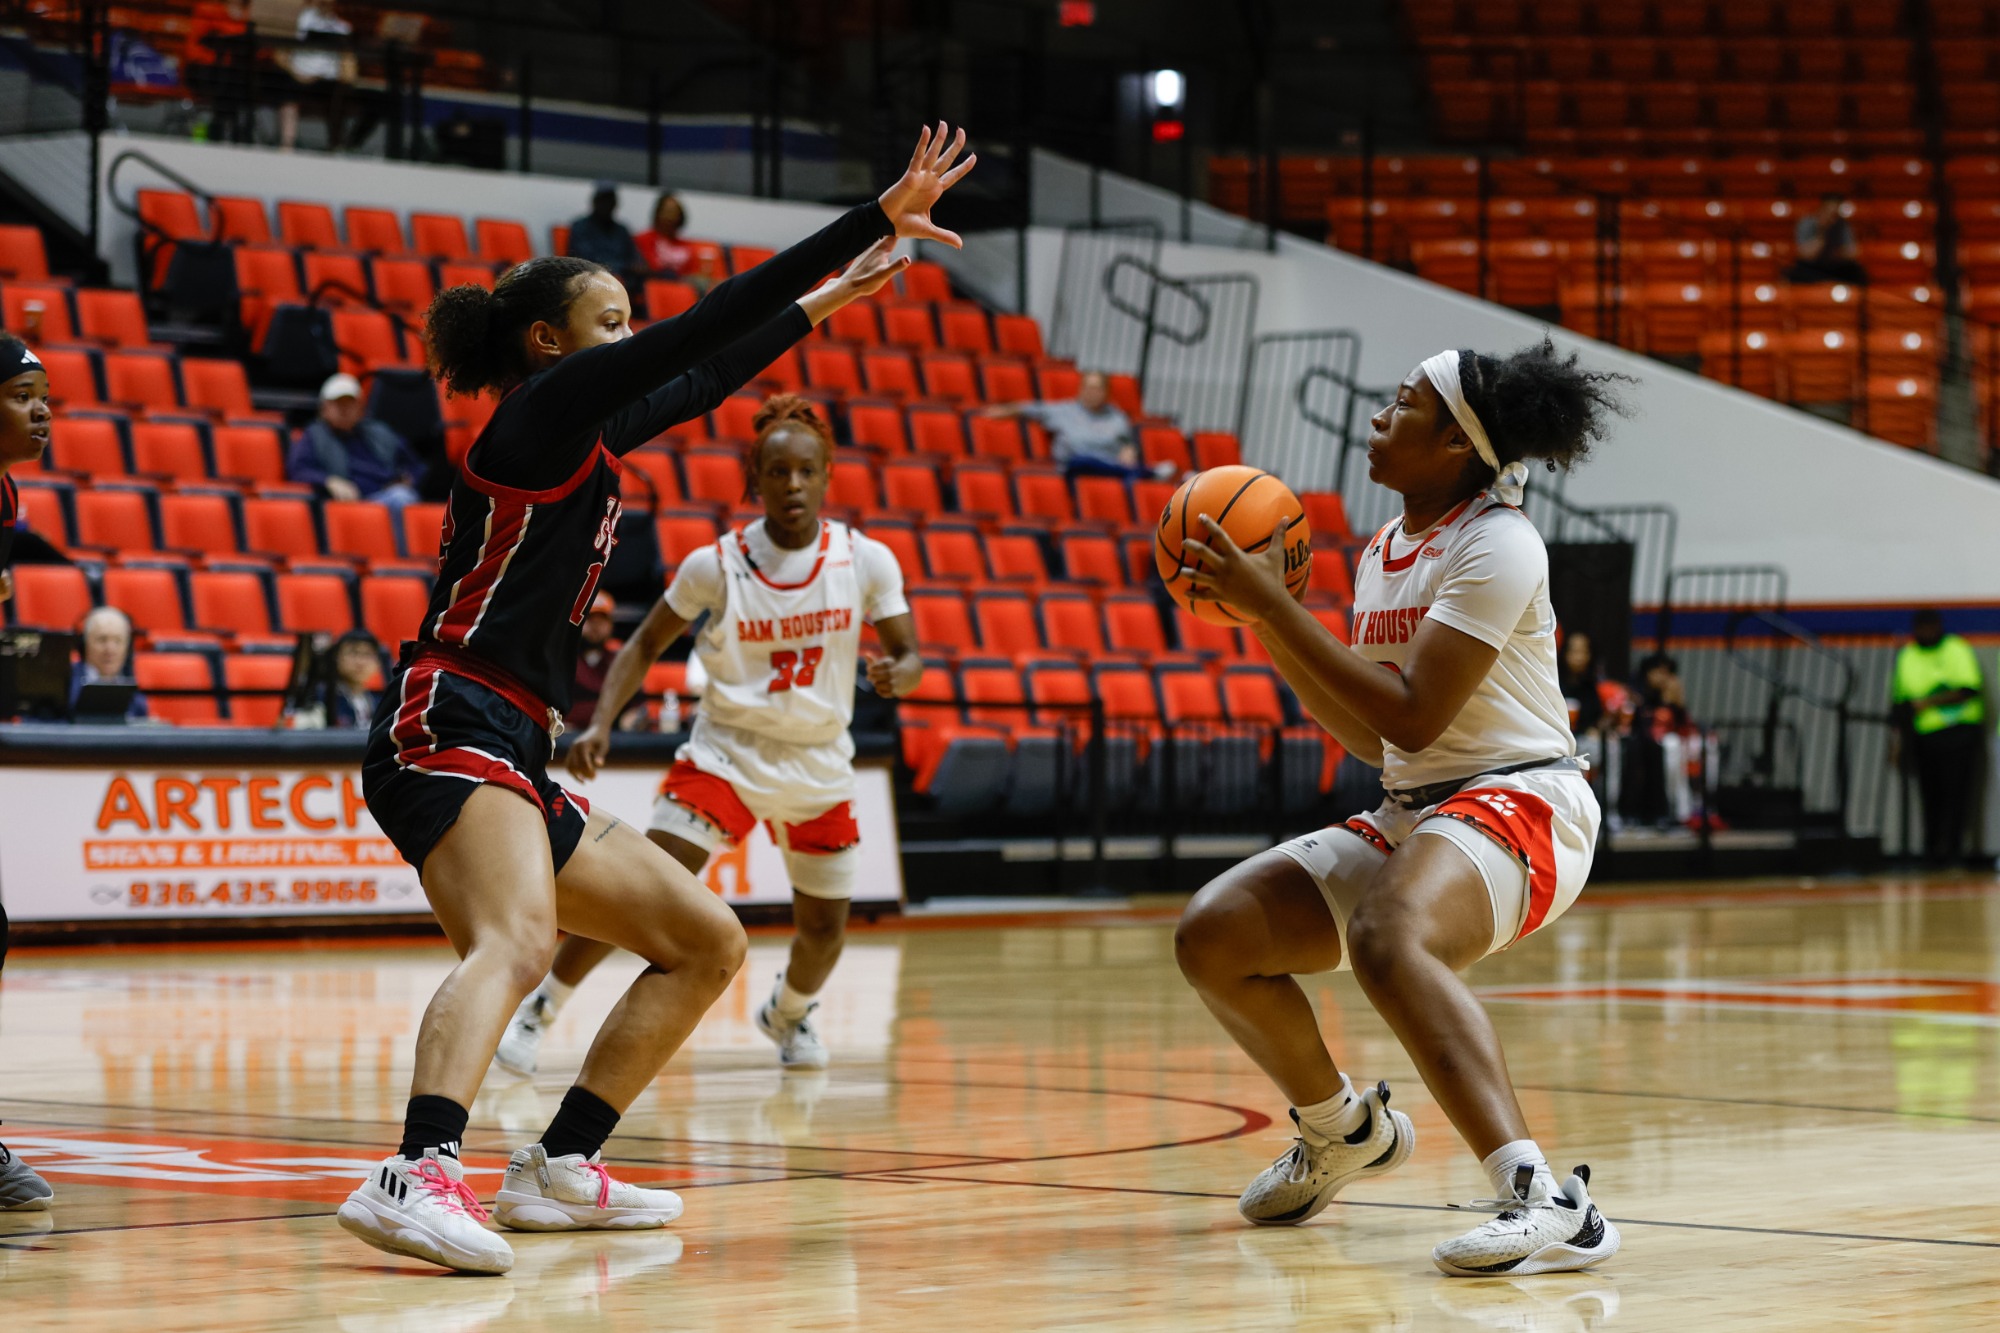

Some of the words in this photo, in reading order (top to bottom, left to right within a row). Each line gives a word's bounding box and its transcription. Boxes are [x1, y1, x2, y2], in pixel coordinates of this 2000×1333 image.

[737, 619, 775, 642] SAM
[780, 607, 852, 640] HOUSTON
[1363, 606, 1431, 645] HOUST
